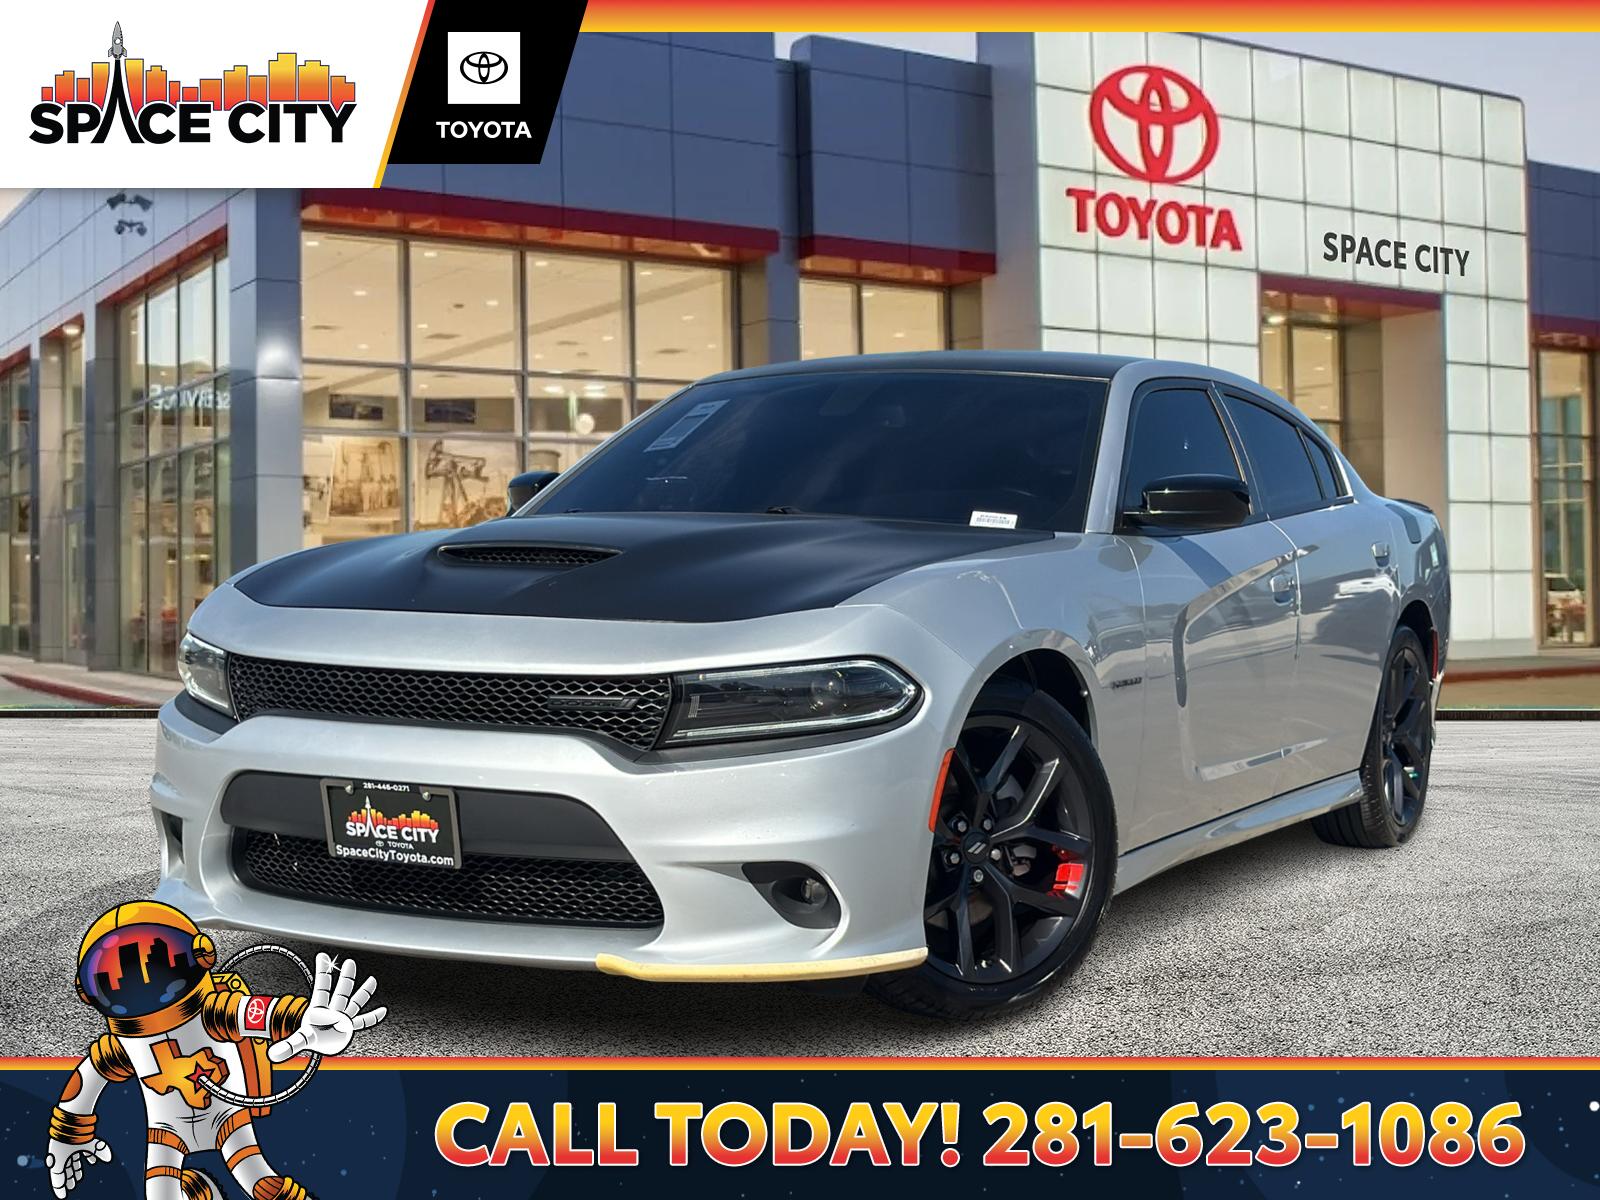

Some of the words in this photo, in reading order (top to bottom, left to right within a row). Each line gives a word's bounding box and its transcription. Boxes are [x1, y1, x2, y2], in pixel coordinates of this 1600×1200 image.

[1066, 187, 1242, 251] TOYOTA
[1322, 231, 1407, 270] SPACE
[1414, 244, 1470, 277] CITY
[387, 840, 415, 850] TOYOTA
[401, 826, 440, 843] CITY
[336, 845, 454, 866] SpaceCityToyota.com
